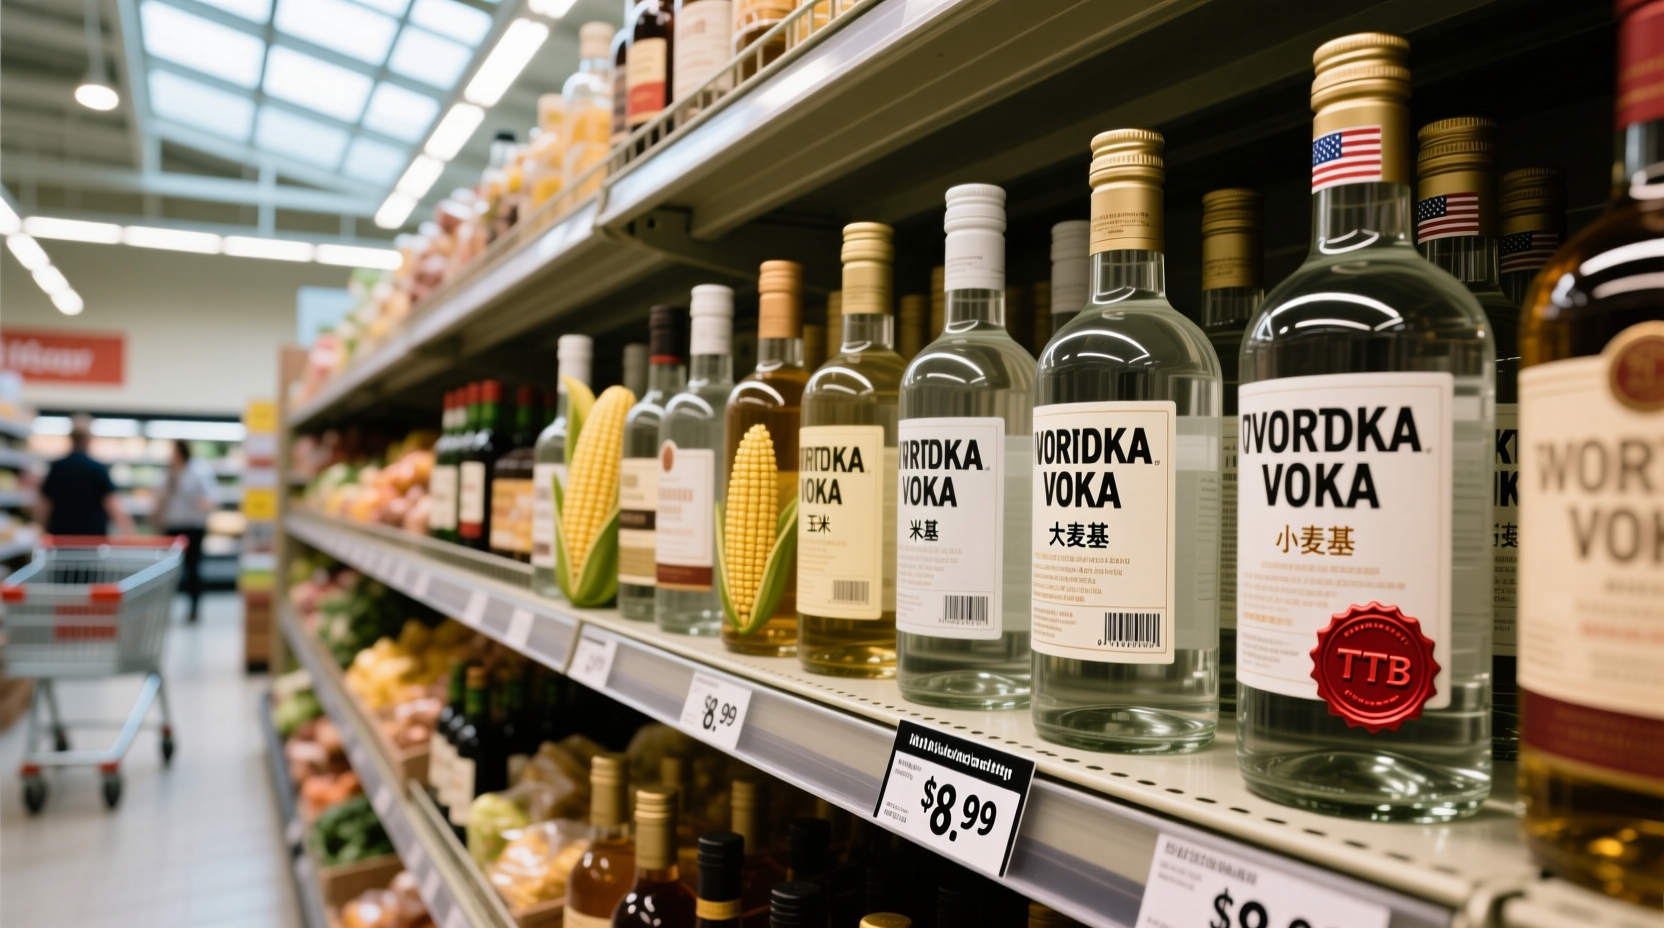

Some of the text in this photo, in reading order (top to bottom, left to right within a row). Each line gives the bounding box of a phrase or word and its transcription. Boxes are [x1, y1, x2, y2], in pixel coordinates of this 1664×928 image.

[902, 475, 957, 508] VOKA
[1043, 471, 1122, 509] VOKA
[1262, 463, 1380, 509] VOKA
[909, 519, 939, 542] 米基
[1049, 521, 1109, 548] 大麦基
[1276, 525, 1355, 556] 小麦基
[1337, 647, 1411, 686] TTB
[920, 775, 997, 842] $8.99
